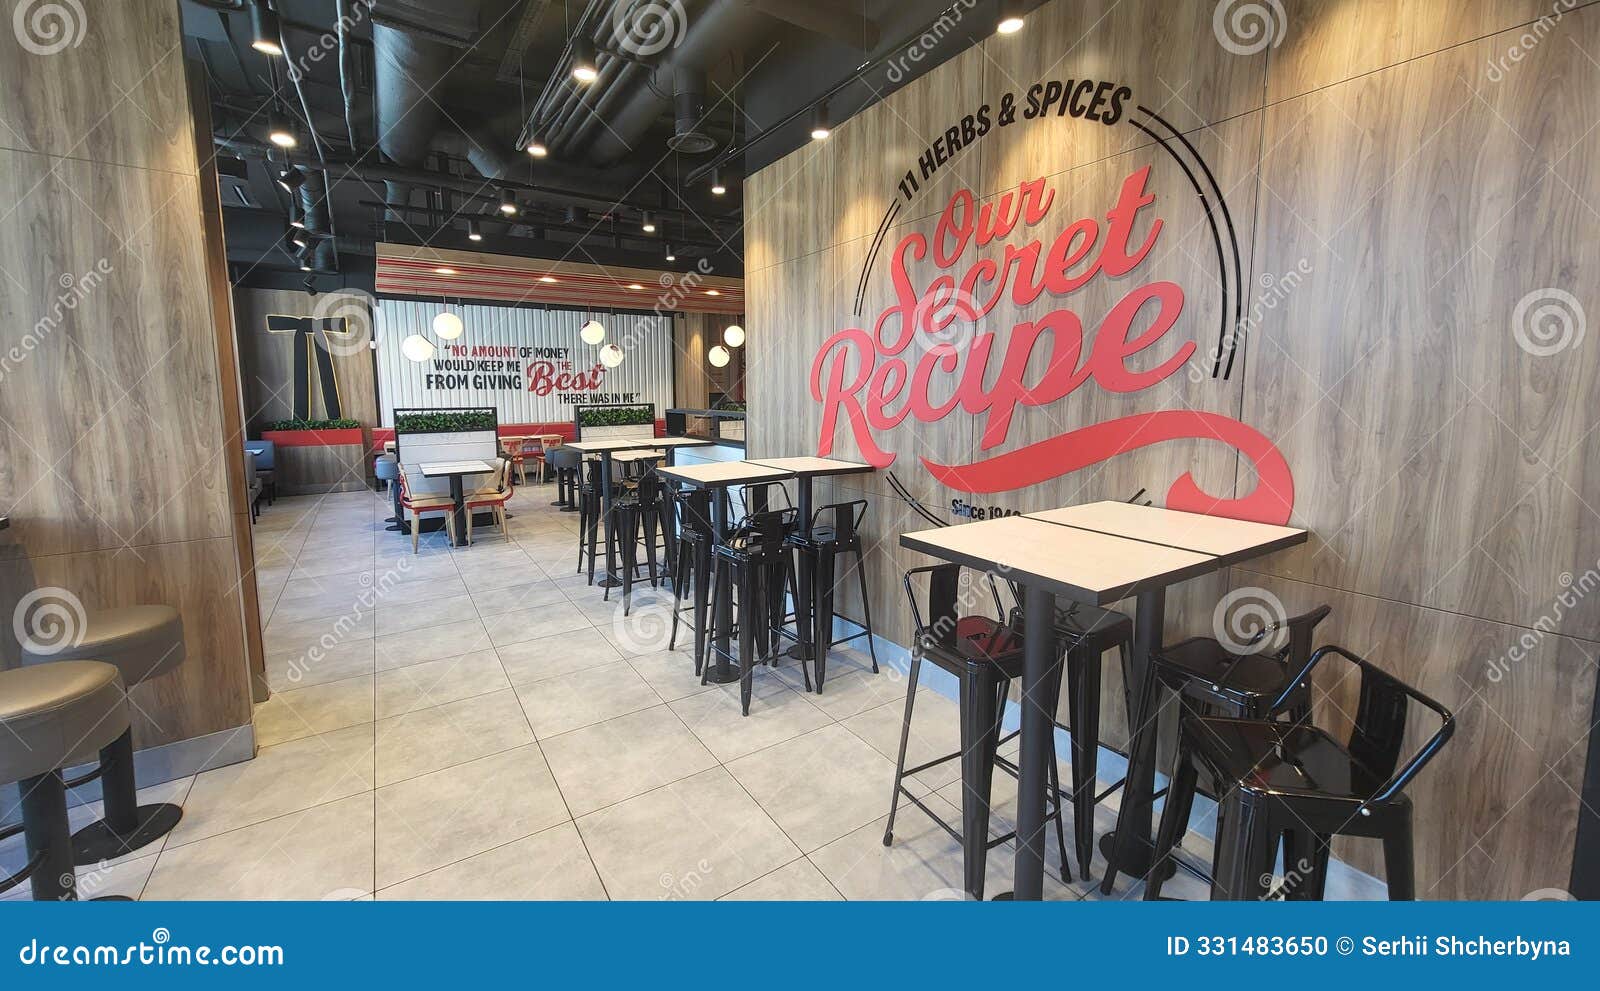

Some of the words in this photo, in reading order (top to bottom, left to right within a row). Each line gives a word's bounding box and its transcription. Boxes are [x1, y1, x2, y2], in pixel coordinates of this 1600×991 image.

[898, 169, 920, 201] 11
[918, 104, 991, 181] HERBS
[998, 92, 1016, 127] &
[1023, 79, 1132, 126] SPICES
[932, 176, 1055, 269] Our
[874, 165, 1163, 357] Secret
[471, 345, 517, 358] AMOUNT
[519, 347, 533, 358] OF
[535, 347, 569, 359] MONEY
[433, 359, 475, 372] WOULD
[477, 360, 504, 372] KEEP
[506, 360, 521, 372] ME
[556, 361, 572, 371] THE
[810, 281, 1197, 468] Recipe
[425, 374, 469, 390] FROM
[472, 374, 522, 390] GIVING
[527, 360, 607, 396] Best
[557, 393, 588, 404] THERE
[589, 393, 609, 404] WAS
[611, 393, 621, 403] IN
[951, 498, 985, 521] Since
